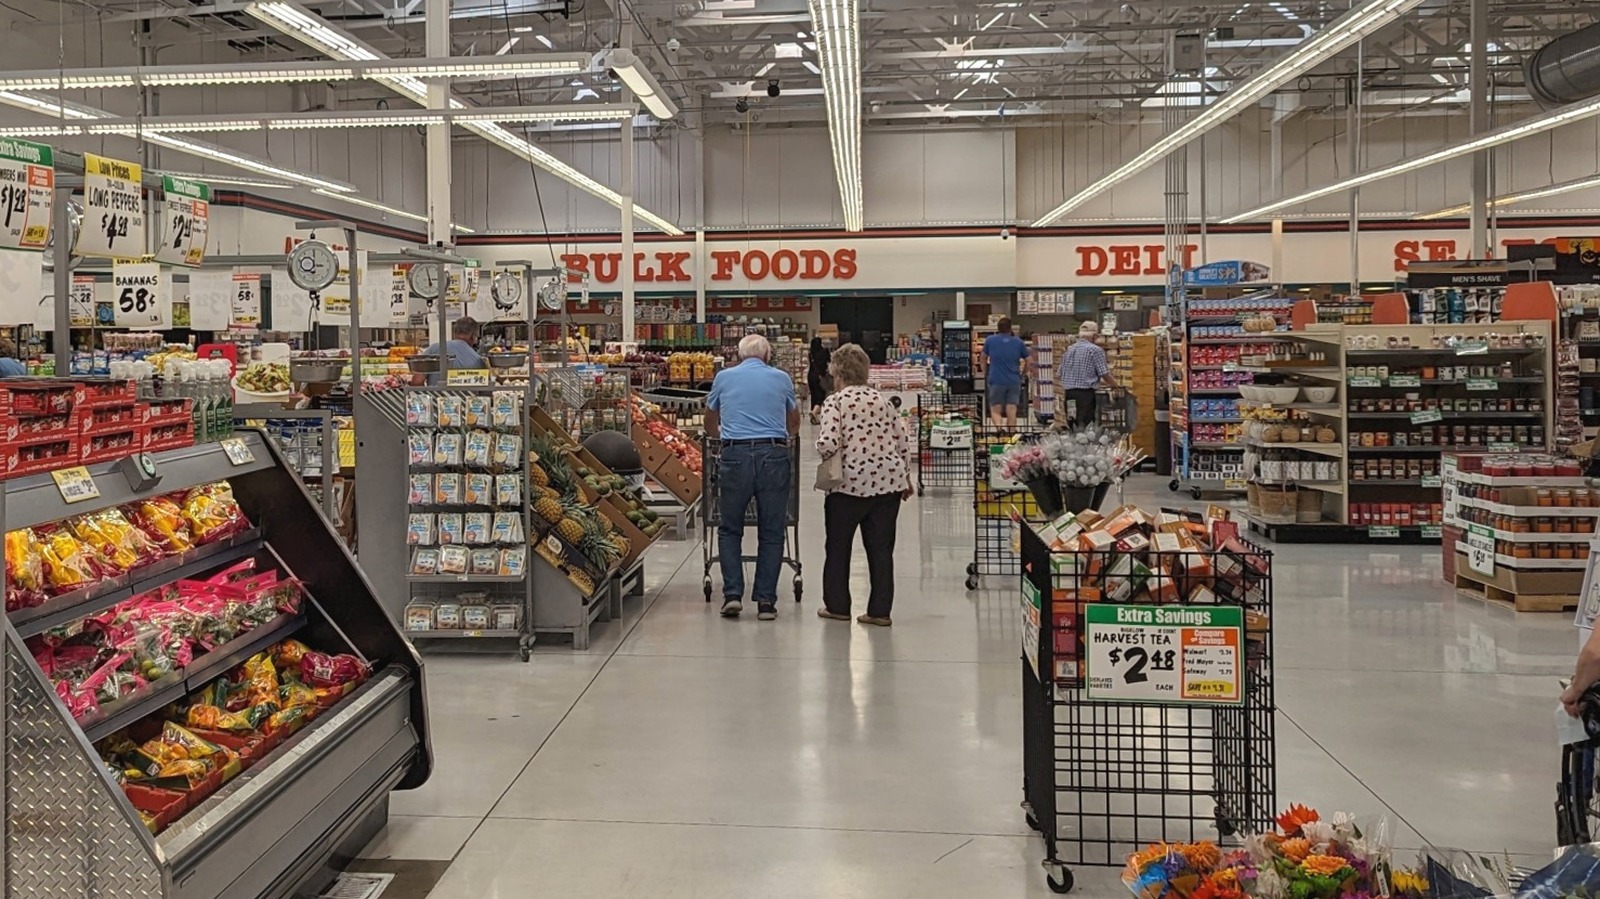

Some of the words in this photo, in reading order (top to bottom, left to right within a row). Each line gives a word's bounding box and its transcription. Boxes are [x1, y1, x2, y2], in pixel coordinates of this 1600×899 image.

[97, 158, 111, 176] Low
[111, 161, 131, 180] Prices
[89, 185, 109, 209] LONG
[111, 190, 140, 214] PEPPERS
[560, 251, 692, 282] BULK
[710, 248, 858, 281] FOODS
[1075, 244, 1199, 276] DELI
[115, 275, 158, 287] BANANAS
[1451, 275, 1476, 283] MEN'S
[1476, 275, 1501, 283] SHAVE
[1117, 607, 1152, 623] Extra
[1155, 608, 1212, 626] Savings
[1094, 632, 1146, 645] HARVEST
[1150, 634, 1172, 645] TEA
